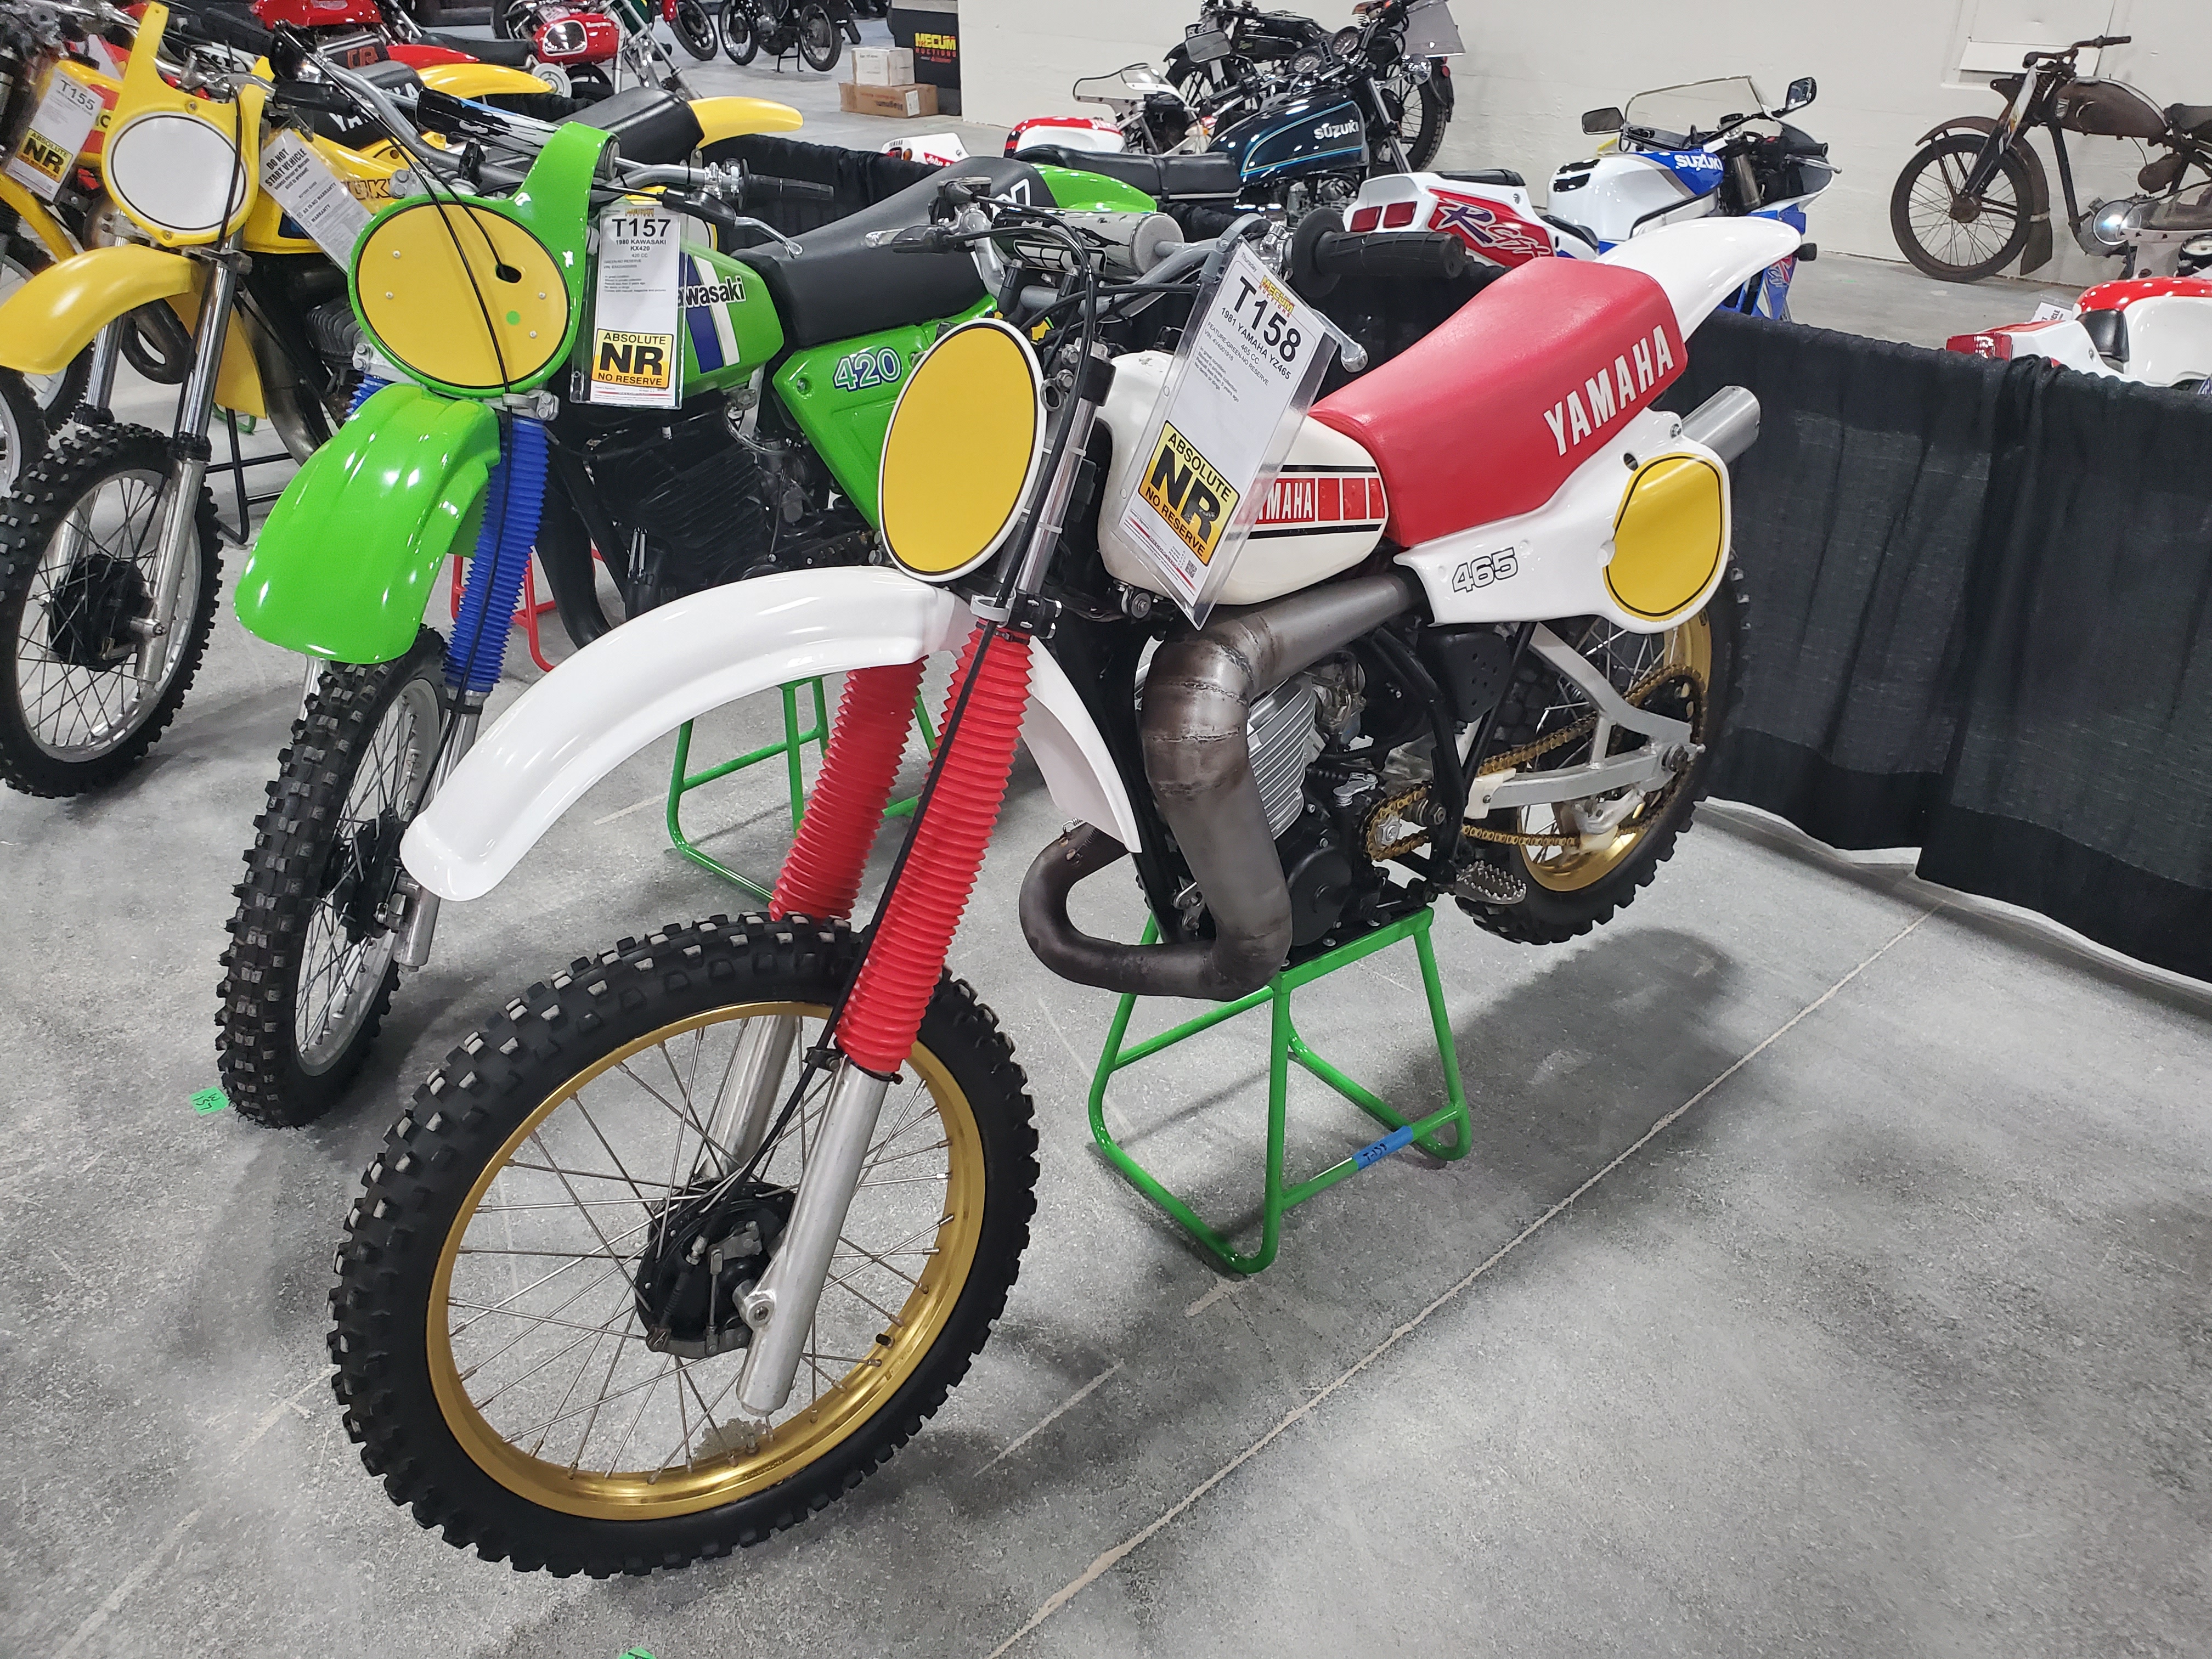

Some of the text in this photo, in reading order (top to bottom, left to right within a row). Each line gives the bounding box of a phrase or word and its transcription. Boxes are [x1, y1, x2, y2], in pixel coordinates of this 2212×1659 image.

[915, 32, 956, 50] MECUM
[60, 80, 95, 110] T155
[31, 132, 68, 159] ABSOLUTE
[1313, 121, 1359, 139] SUZUKI
[24, 137, 64, 174] NR
[265, 148, 307, 187] START VEHICLE
[266, 148, 290, 170] DO NOT
[1674, 155, 1723, 171] SUZUKI
[612, 218, 671, 238] T157
[1241, 252, 1257, 273] Thursday
[678, 276, 746, 308] awasaki
[1261, 274, 1295, 314] MECUM
[1234, 275, 1301, 362] T158
[604, 332, 667, 345] ABSOLUTE
[1207, 321, 1269, 386] FEATURE-GREEN-NO RESERVE
[1221, 307, 1291, 380] 1981 YAMAHA YZ465
[1240, 344, 1260, 364] 465 CC
[600, 342, 664, 376] NR
[833, 347, 902, 392] 420
[598, 373, 663, 386] NO RESERVE
[1543, 325, 1675, 457] YAMAHA
[1167, 432, 1232, 503] ABSOLUTE
[1150, 443, 1221, 545] NR
[1259, 482, 1313, 521] MAHA
[1145, 486, 1161, 507] NO
[1161, 505, 1206, 558] RESERVE
[1452, 546, 1519, 593] 465
